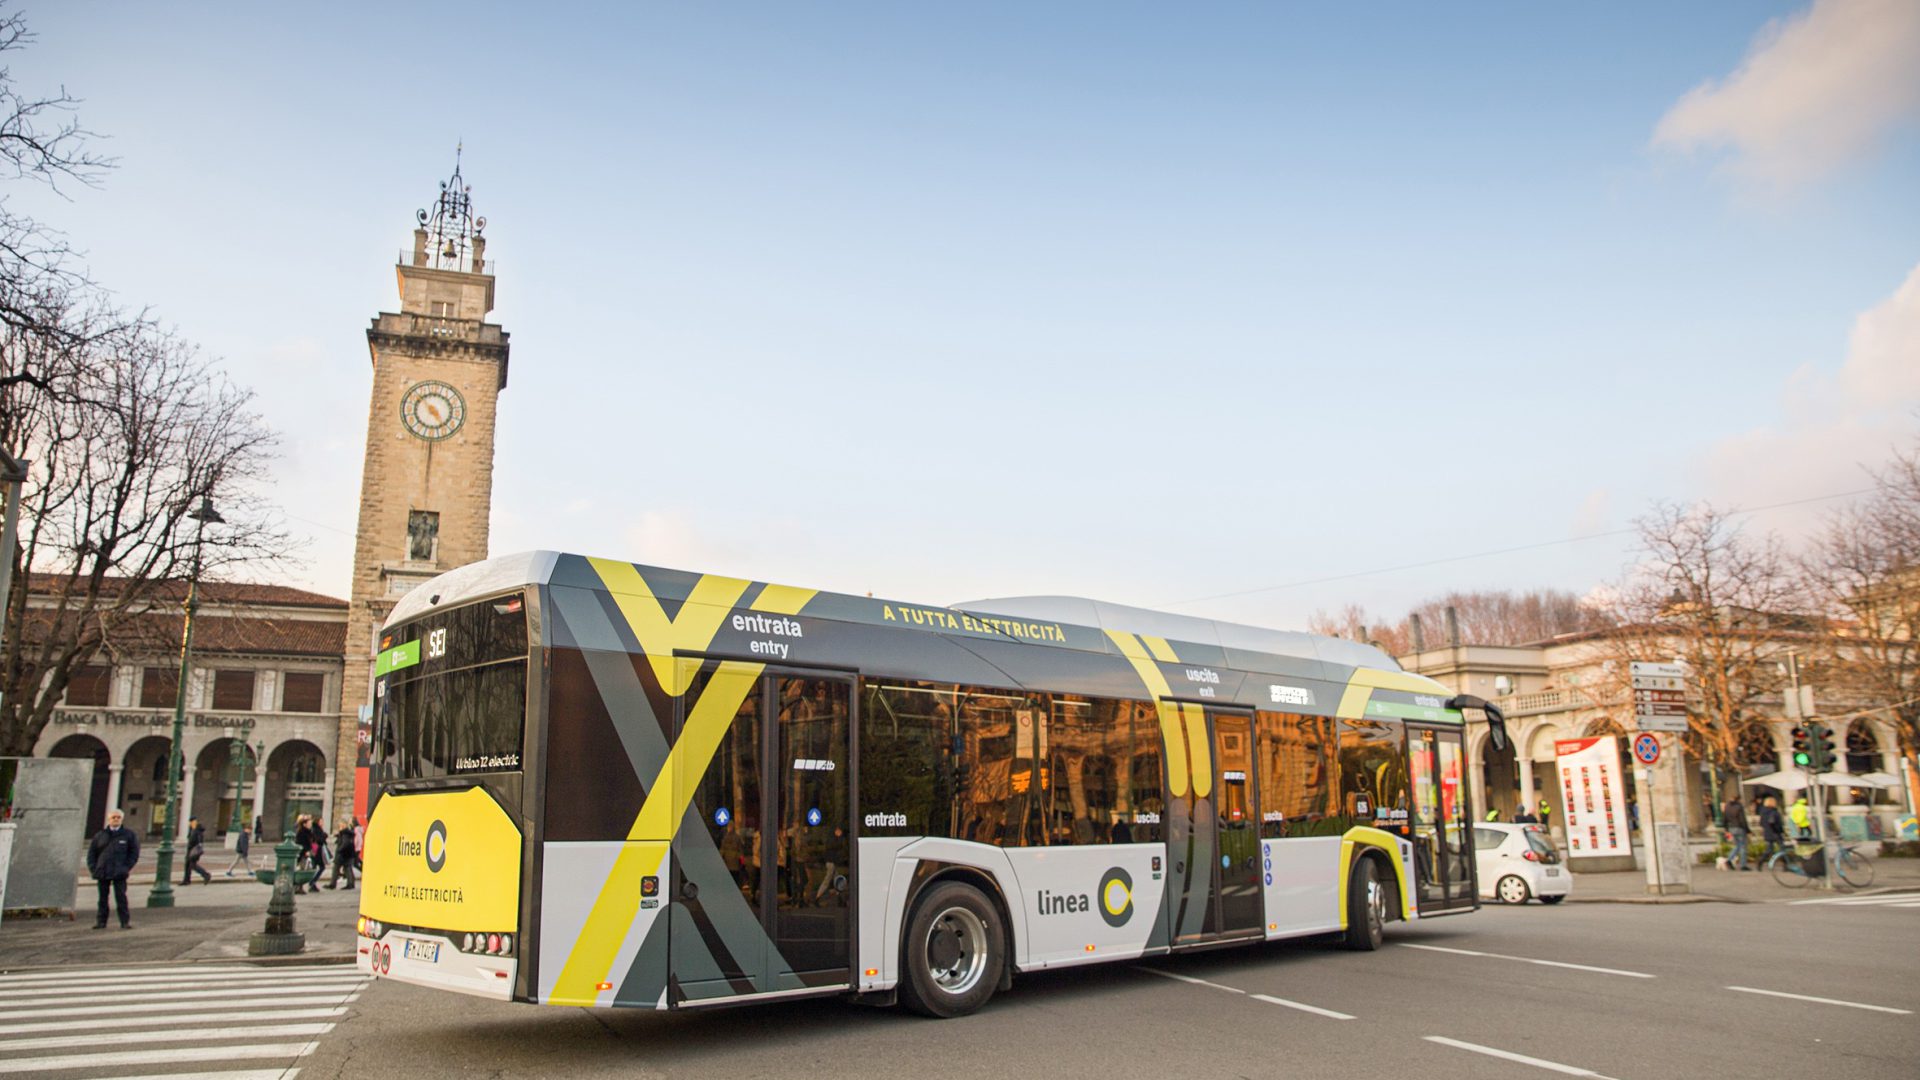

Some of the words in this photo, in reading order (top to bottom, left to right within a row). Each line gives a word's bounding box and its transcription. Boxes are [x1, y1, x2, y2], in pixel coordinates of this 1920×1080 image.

[732, 614, 803, 637] entrata
[883, 605, 896, 621] A
[898, 607, 959, 630] TUTTA
[961, 617, 1067, 643] ELETTRICITÀ
[750, 640, 789, 659] entry
[1185, 668, 1220, 684] uscita
[54, 711, 98, 725] BANCA
[104, 712, 172, 728] POPOLARE
[194, 714, 256, 729] BERGAMO
[456, 757, 480, 770] Urbino
[480, 755, 488, 768] 12
[488, 753, 519, 768] electric
[864, 811, 907, 827] entrata
[1136, 811, 1161, 824] uscita
[398, 835, 421, 856] linea
[384, 885, 388, 896] A
[389, 885, 409, 899] TUTTA
[411, 887, 463, 903] ELETTRICITÀ
[1038, 889, 1090, 916] linea
